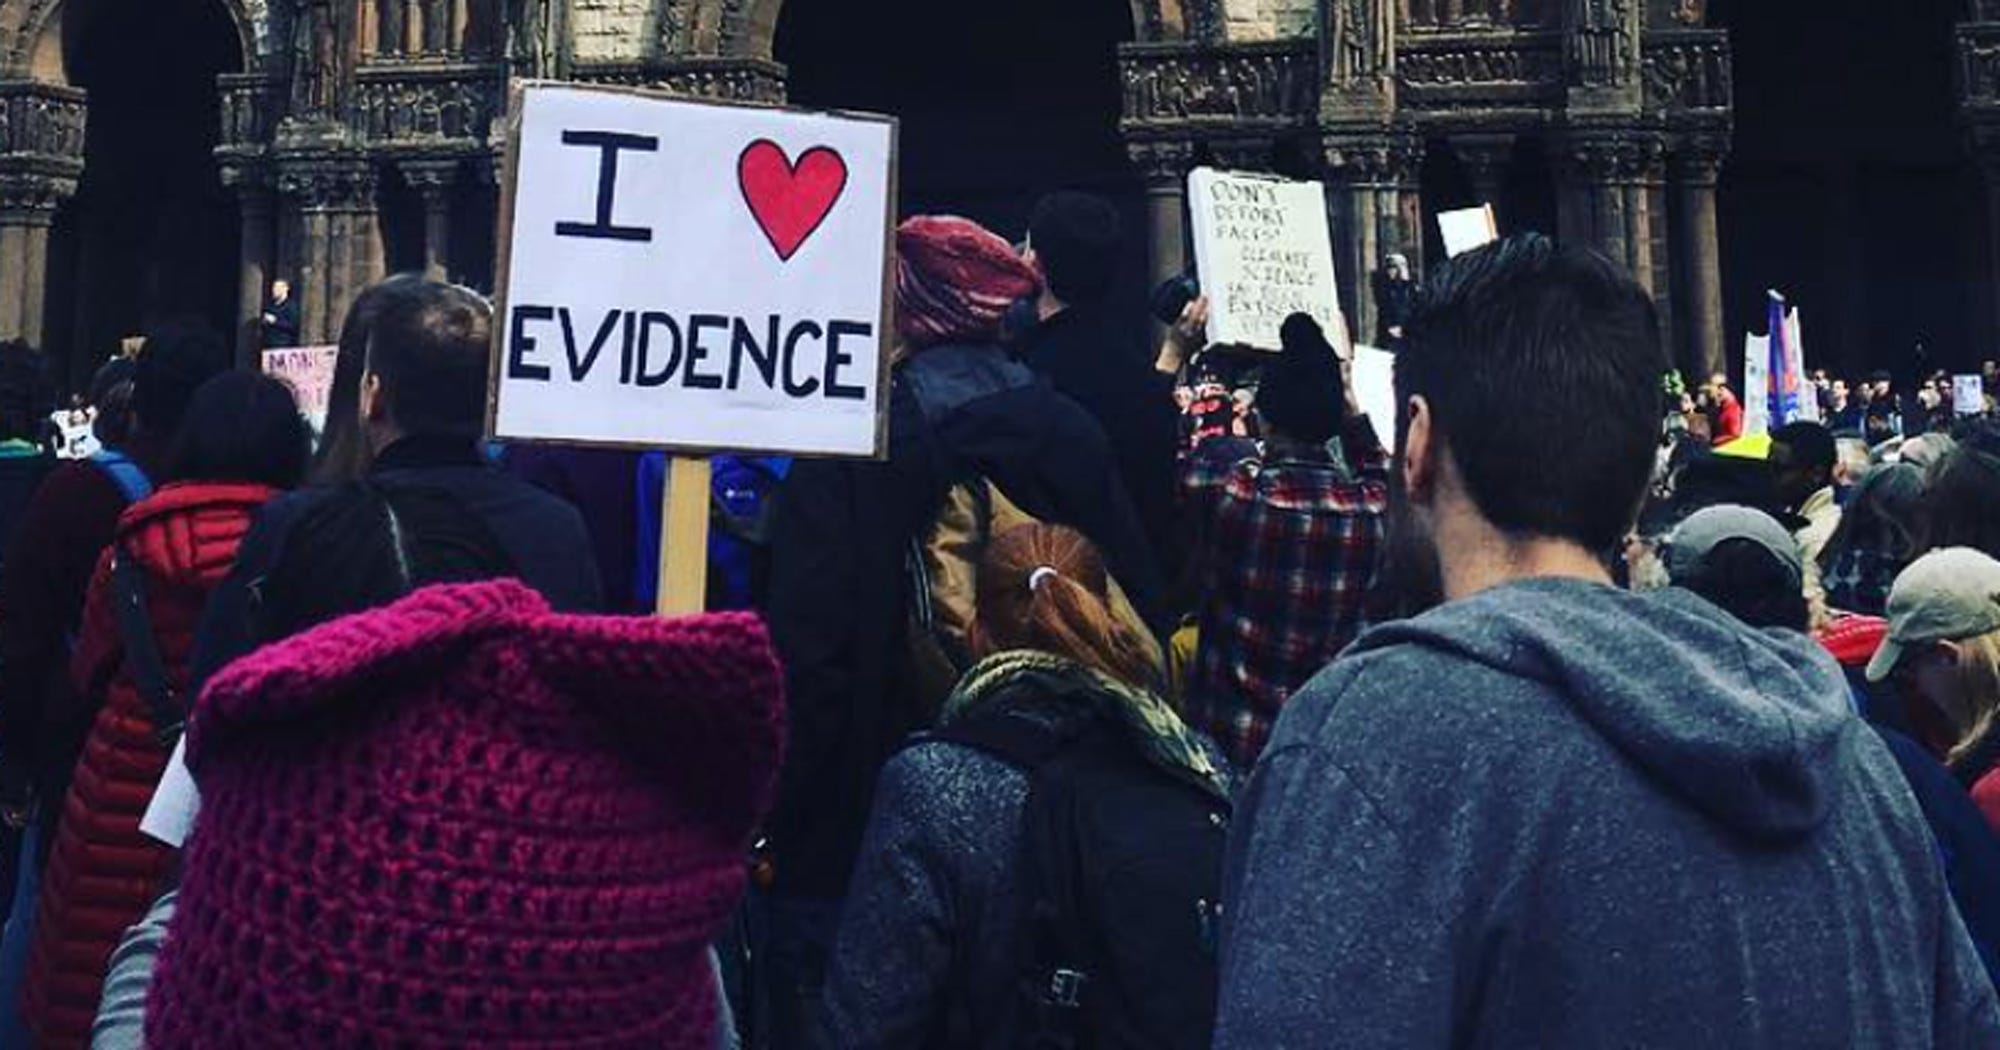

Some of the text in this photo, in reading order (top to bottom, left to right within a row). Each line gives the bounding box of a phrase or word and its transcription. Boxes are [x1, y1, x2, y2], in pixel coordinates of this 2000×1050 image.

[555, 130, 659, 241] I
[1209, 180, 1280, 205] DON'T
[1241, 245, 1311, 269] CLIMATE
[1241, 265, 1319, 286] SCIENCE
[508, 305, 872, 400] EVIDENCE
